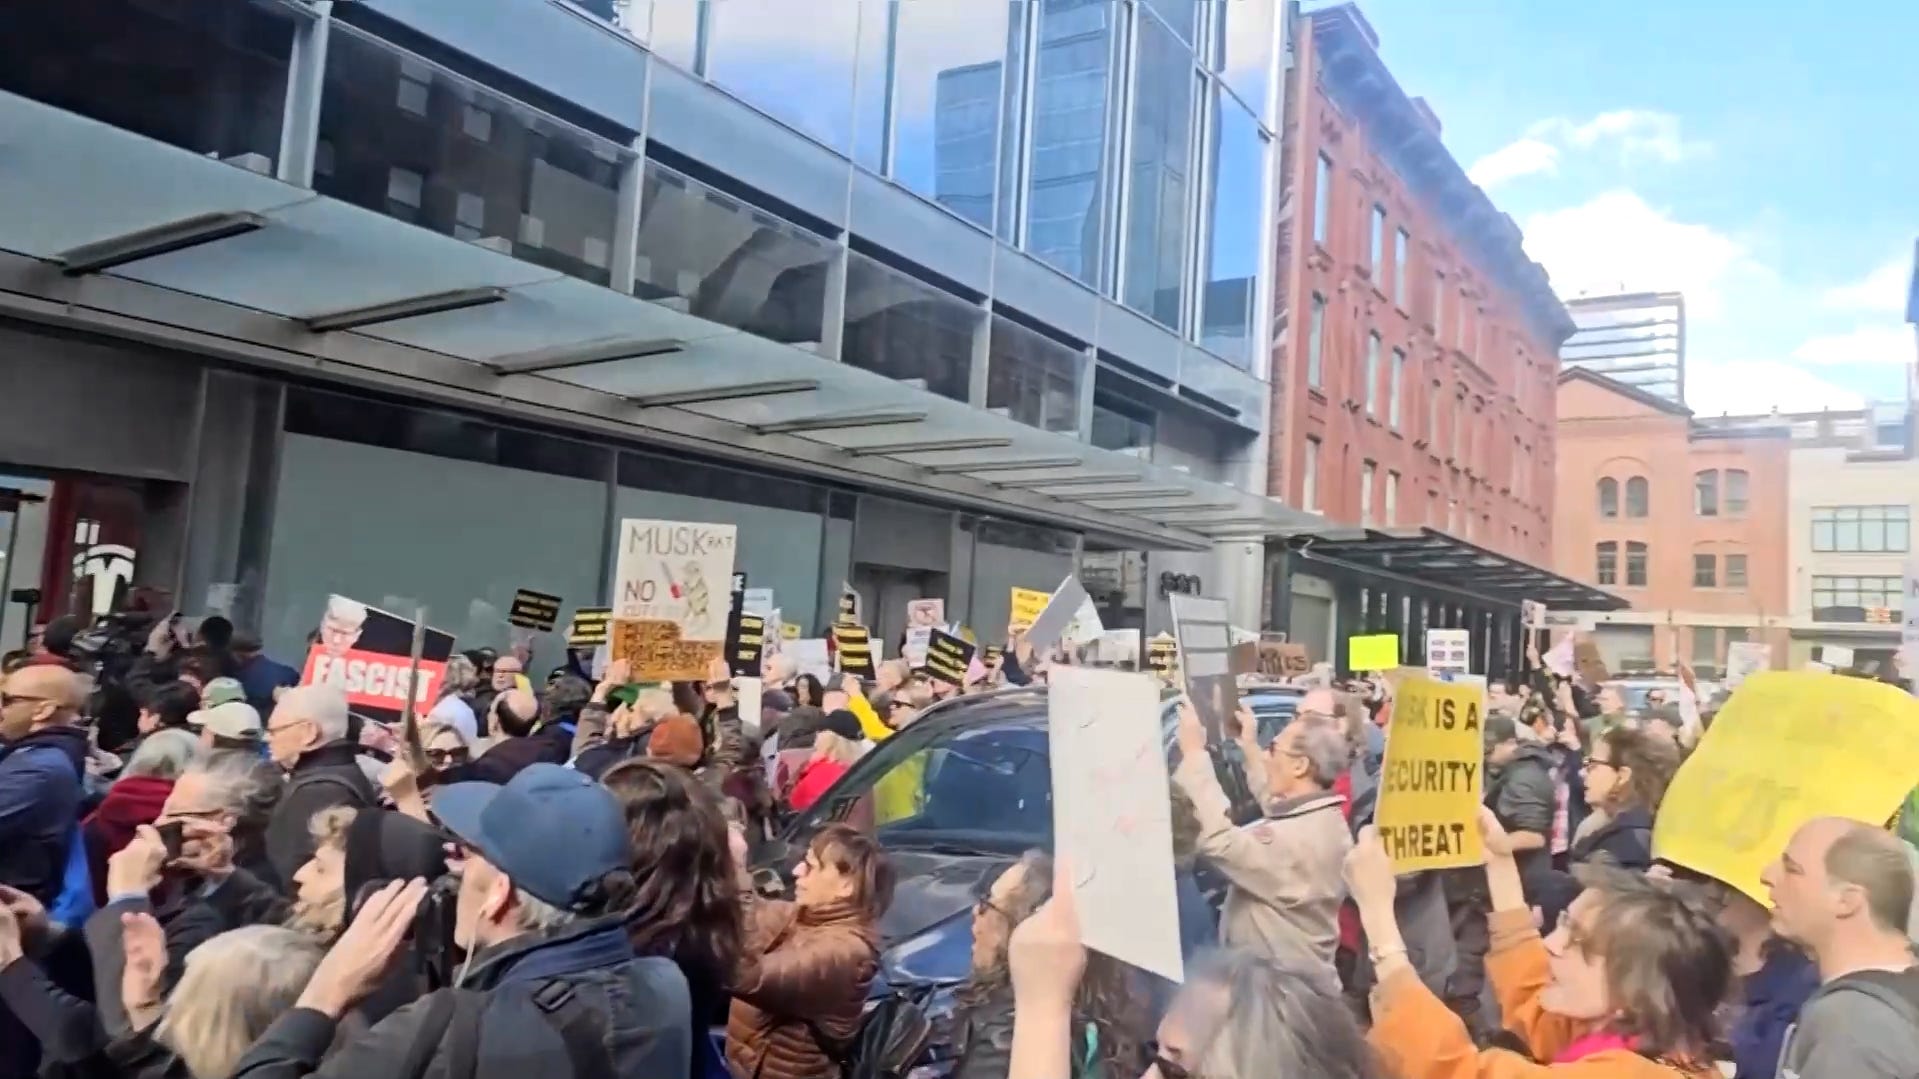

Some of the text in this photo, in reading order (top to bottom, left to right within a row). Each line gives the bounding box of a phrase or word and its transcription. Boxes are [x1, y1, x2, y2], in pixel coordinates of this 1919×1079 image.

[624, 580, 655, 602] NO
[309, 654, 435, 702] FASCIST
[1434, 699, 1456, 730] IS
[1464, 703, 1479, 731] A
[1385, 760, 1476, 793] ECURITY
[1380, 822, 1464, 860] THREAT
